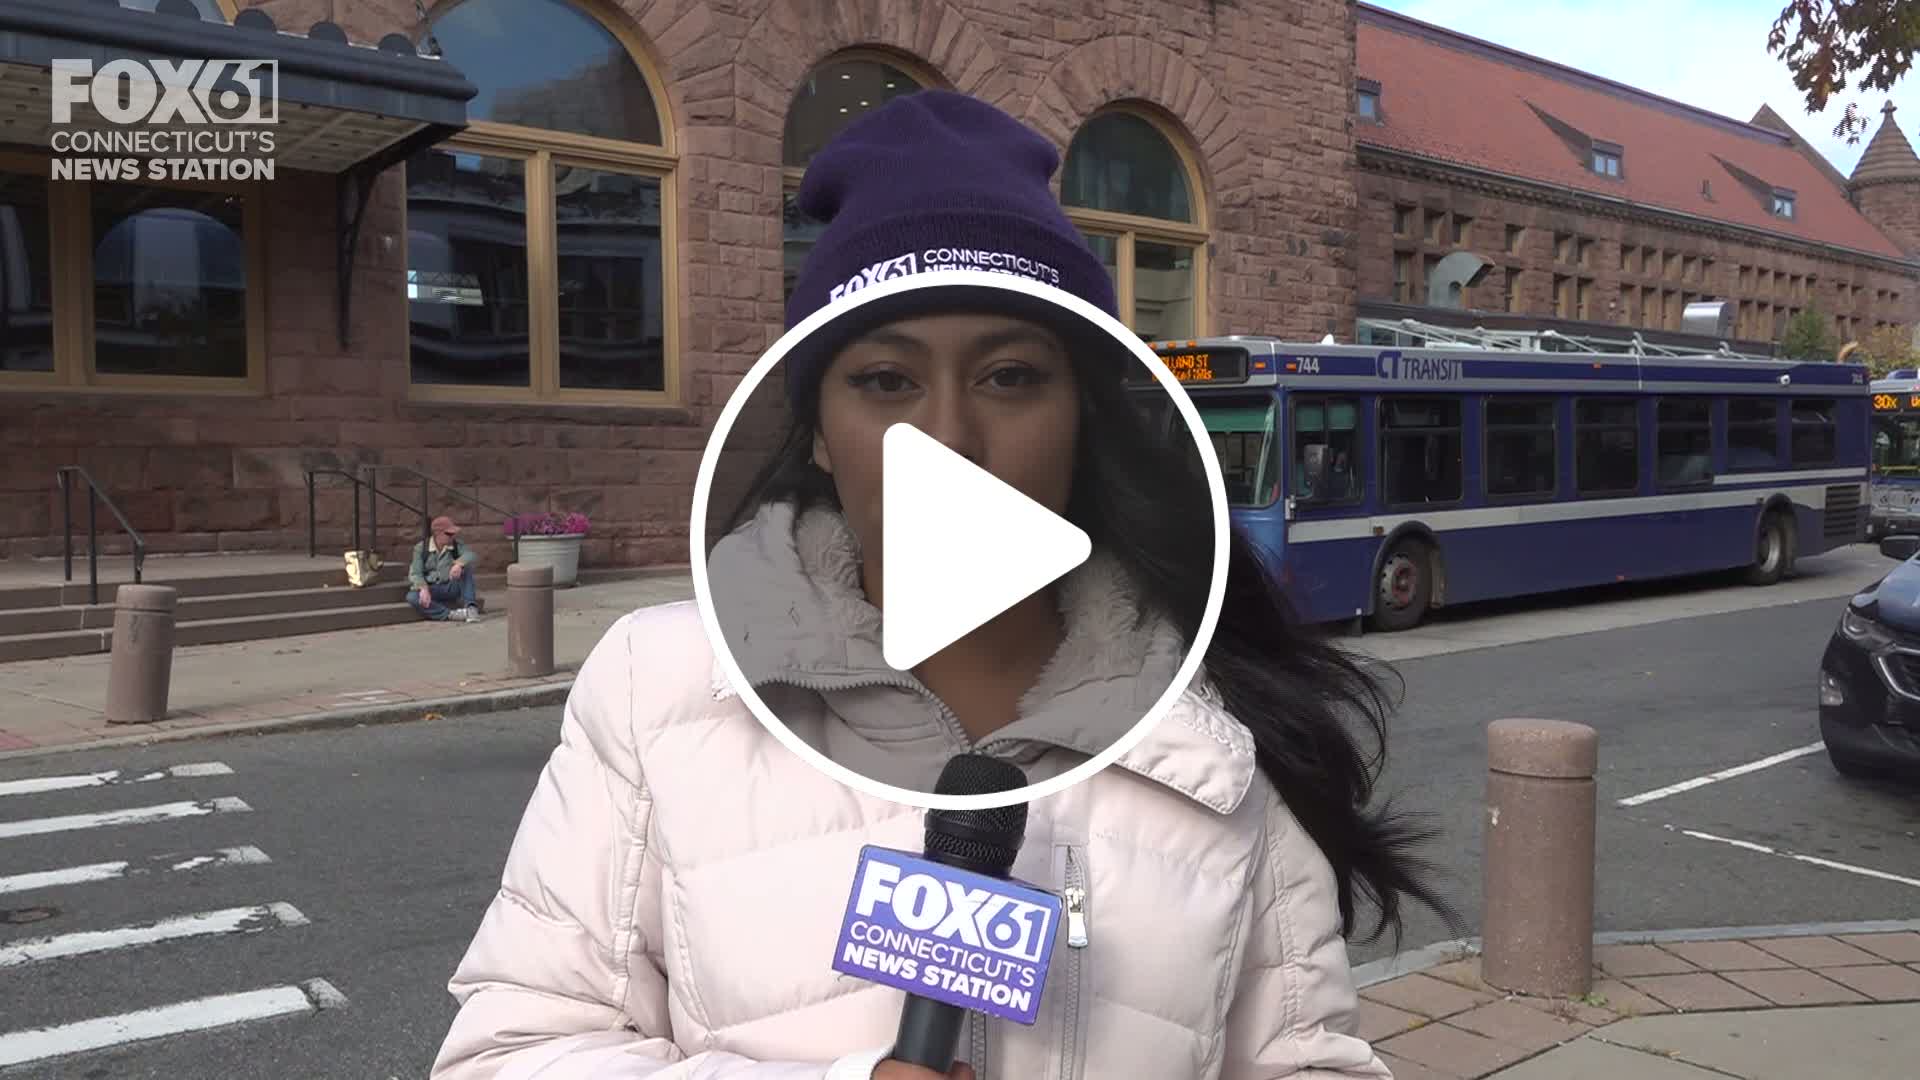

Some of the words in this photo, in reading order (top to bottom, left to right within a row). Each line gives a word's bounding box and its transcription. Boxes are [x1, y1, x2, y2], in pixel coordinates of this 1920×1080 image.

[923, 248, 1060, 283] CONNECTICUT'S
[1296, 356, 1320, 374] 744
[1377, 350, 1401, 379] CT
[1402, 357, 1463, 380] TRANSIT
[855, 859, 1051, 963] FOX61
[842, 942, 919, 981] NEWS
[921, 963, 1032, 1013] STATION
[850, 920, 1036, 988] CONNECTICUT'S
